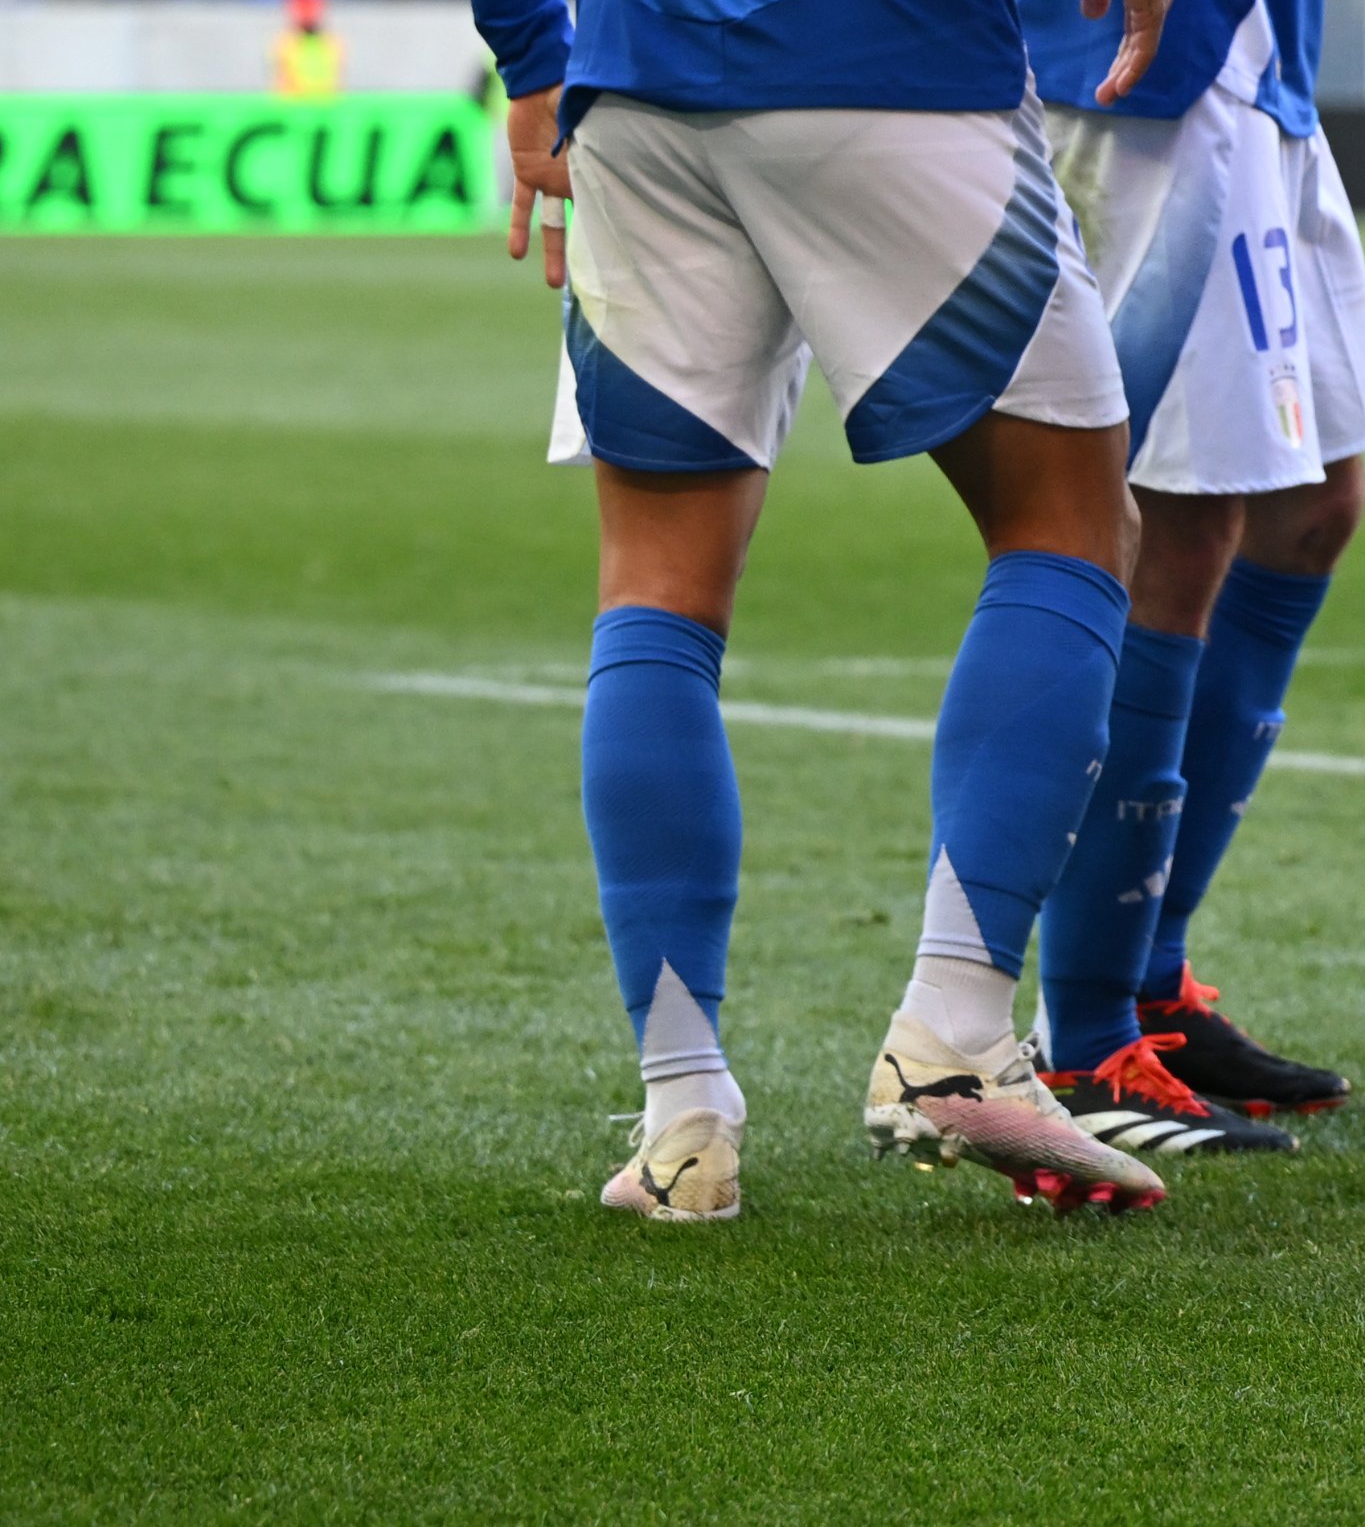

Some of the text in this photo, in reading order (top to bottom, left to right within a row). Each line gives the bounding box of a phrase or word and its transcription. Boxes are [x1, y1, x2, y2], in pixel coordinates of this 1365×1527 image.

[0, 122, 471, 208] A ECUA
[1231, 226, 1298, 352] 13
